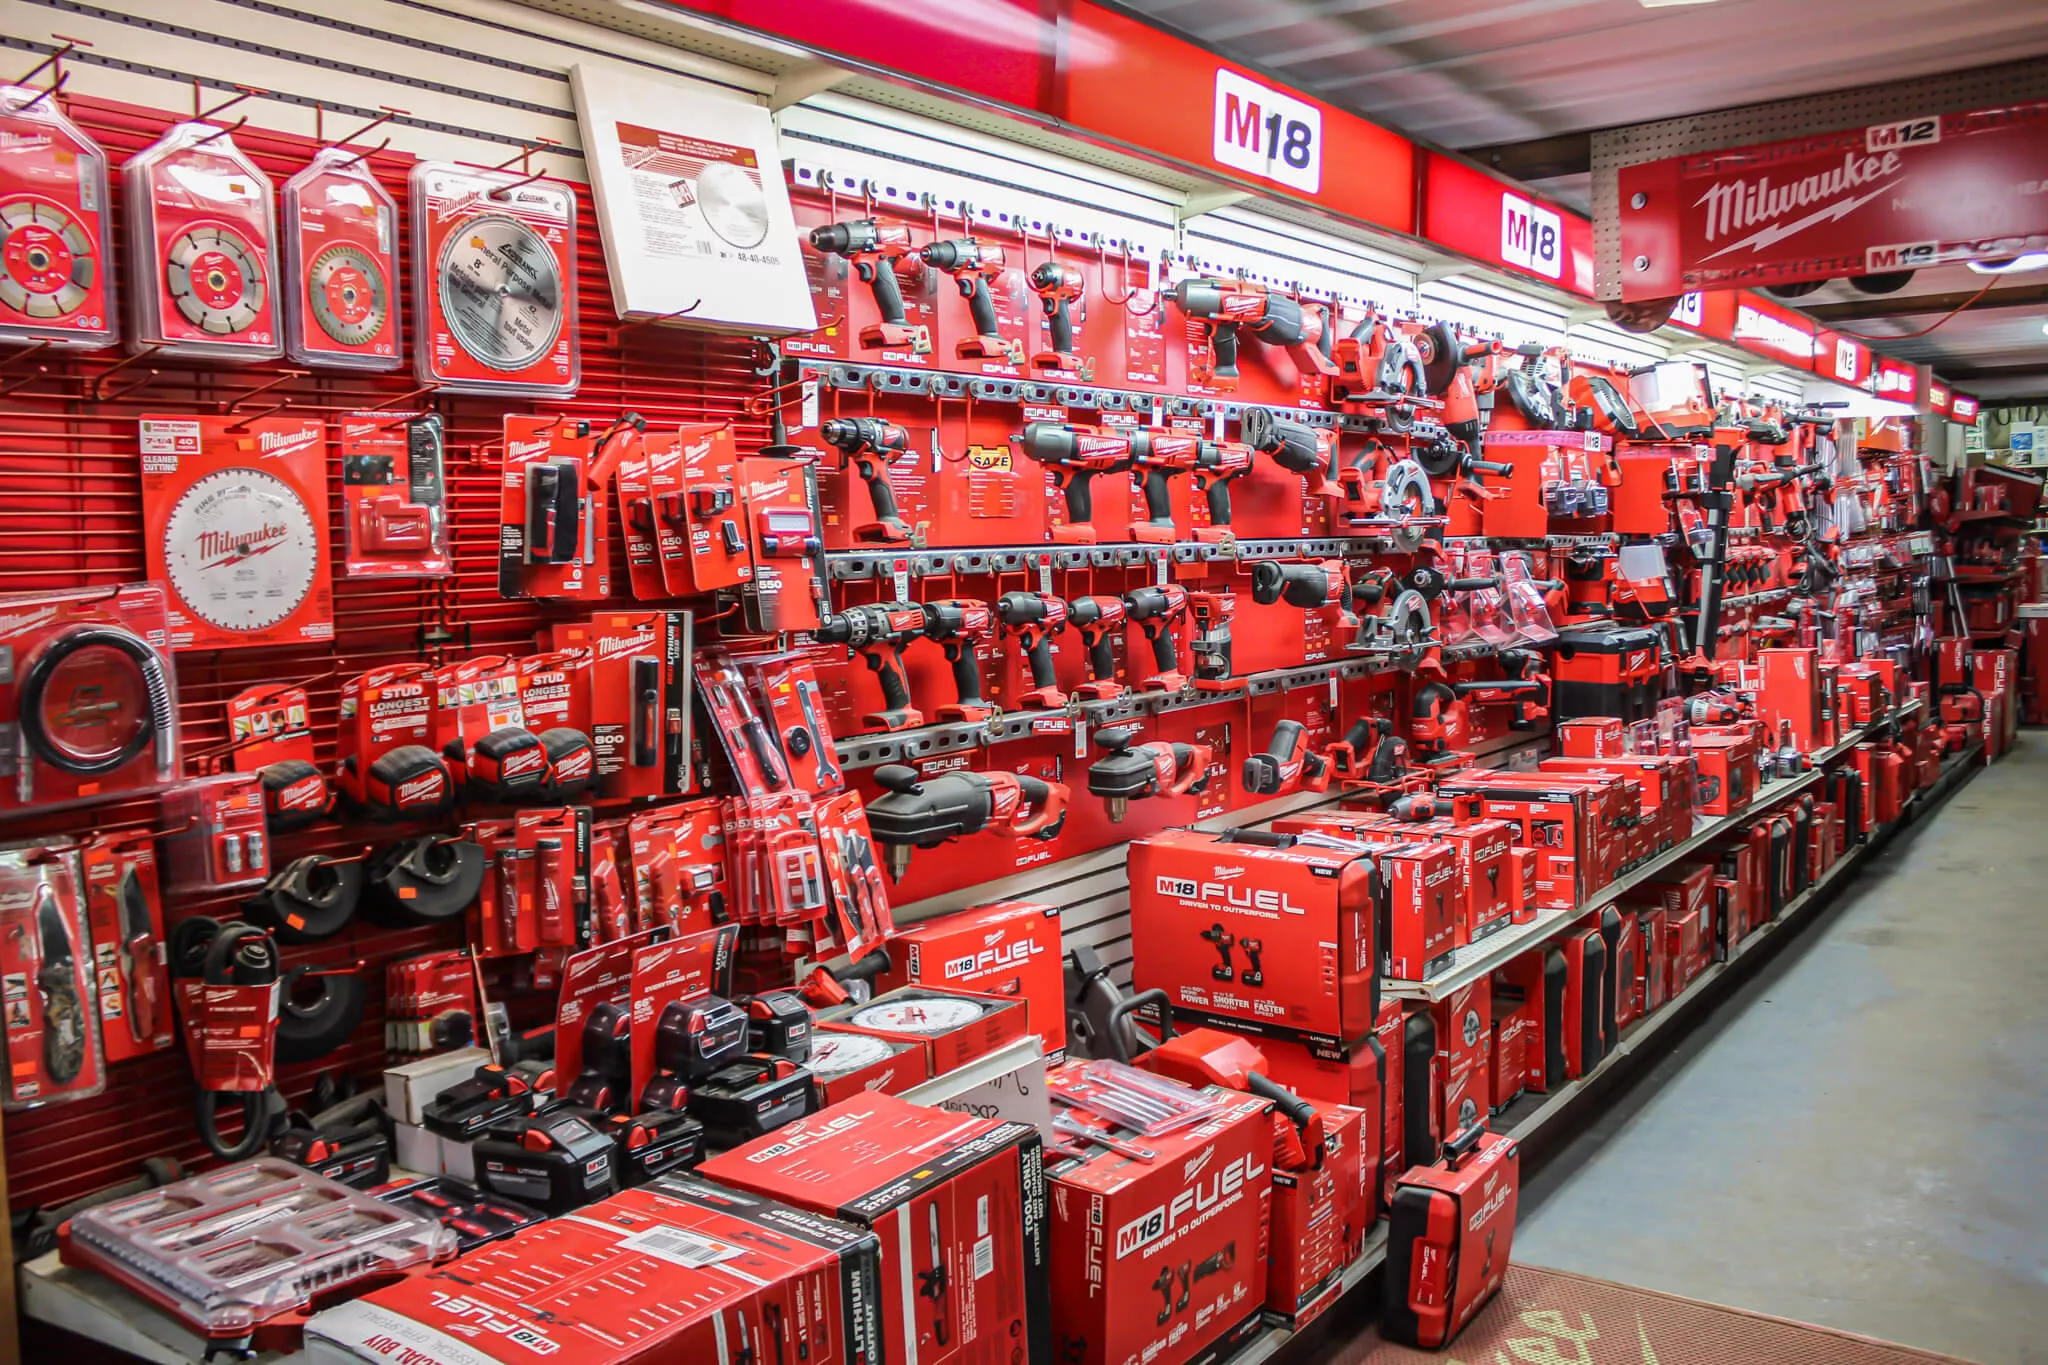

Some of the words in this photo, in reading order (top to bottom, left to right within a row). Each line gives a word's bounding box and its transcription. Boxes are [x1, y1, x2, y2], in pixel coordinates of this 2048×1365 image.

[1225, 92, 1312, 169] M18
[1871, 121, 1935, 147] M12
[1692, 151, 1902, 241] Milwaukee
[1507, 209, 1555, 261] M18
[800, 342, 835, 354] FUEL
[896, 353, 927, 364] FUEL
[1036, 409, 1067, 419] FUEL
[1114, 414, 1139, 425] FUEL
[178, 437, 194, 446] 40
[257, 428, 319, 453] Milwaukee
[1080, 437, 1128, 452] Milwaukee
[974, 456, 1009, 467] SALE
[195, 523, 288, 561] Milwaukee
[661, 536, 683, 545] 450
[692, 531, 710, 540] 450
[759, 580, 783, 589] 550
[597, 632, 656, 656] Milwaukee
[533, 673, 566, 686] STUD
[382, 686, 423, 699] STUD
[523, 684, 571, 698] LONGEST
[370, 697, 430, 713] LONGEST
[1043, 720, 1070, 730] FUEL
[594, 735, 625, 744] 800
[937, 757, 969, 769] FUEL
[764, 817, 779, 828] 5X
[1485, 841, 1508, 856] FUEL
[1314, 868, 1333, 876] NEW
[1159, 880, 1196, 896] M18
[1201, 882, 1305, 915] FUEL
[1179, 900, 1208, 909] DRIVEN
[1210, 904, 1221, 912] TO
[911, 946, 919, 974] M18
[948, 959, 973, 975] M18
[977, 938, 1045, 970] FUEL
[1181, 994, 1209, 1006] POWER
[1213, 995, 1249, 1009] SHORTER
[1254, 1003, 1285, 1015] FASTER
[1316, 1049, 1341, 1059] NEW
[752, 1143, 787, 1162] M18
[787, 1110, 876, 1147] FUEL
[1030, 1147, 1038, 1197] CHARGER
[1035, 1144, 1044, 1196] INCLUDED
[1021, 1152, 1034, 1236] TOOL-ONLY
[1120, 1214, 1163, 1252] M18
[1169, 1151, 1265, 1229] FUEL
[1483, 1184, 1512, 1218] FUEL
[1033, 1222, 1041, 1266] BATTERY
[1143, 1234, 1176, 1259] DRIVEN
[1177, 1226, 1189, 1238] TO
[1090, 1226, 1103, 1298] FUEL
[429, 1291, 519, 1334] FUEL
[864, 1303, 876, 1363] OUTPUT
[362, 1333, 401, 1355] BUY
[512, 1330, 556, 1352] M18
